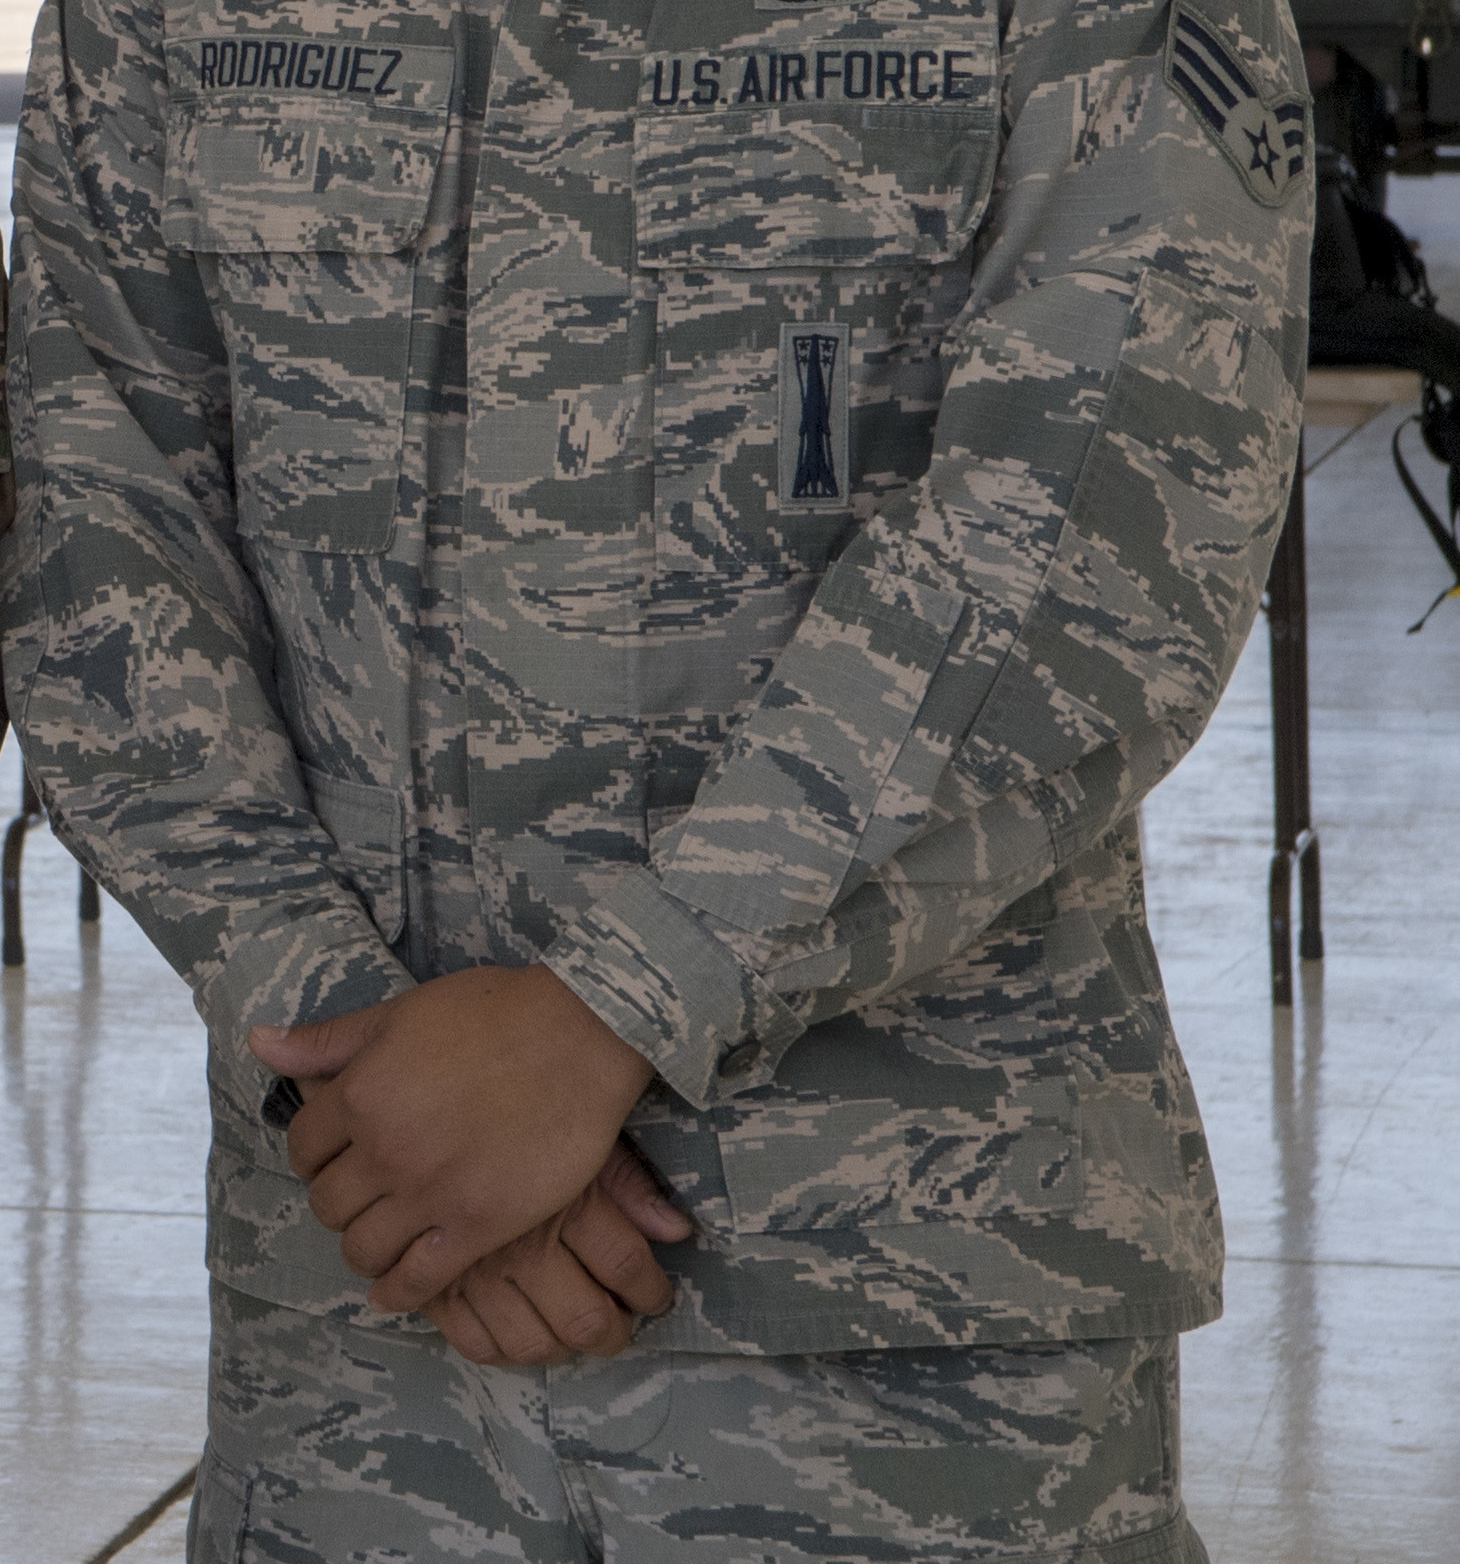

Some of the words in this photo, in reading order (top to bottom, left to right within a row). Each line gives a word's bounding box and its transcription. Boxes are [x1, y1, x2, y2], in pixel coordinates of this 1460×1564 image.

[201, 40, 403, 95] RODRIGUEZ
[652, 58, 728, 106] U.S.
[737, 52, 807, 103] AIR
[815, 49, 974, 100] FORCE
